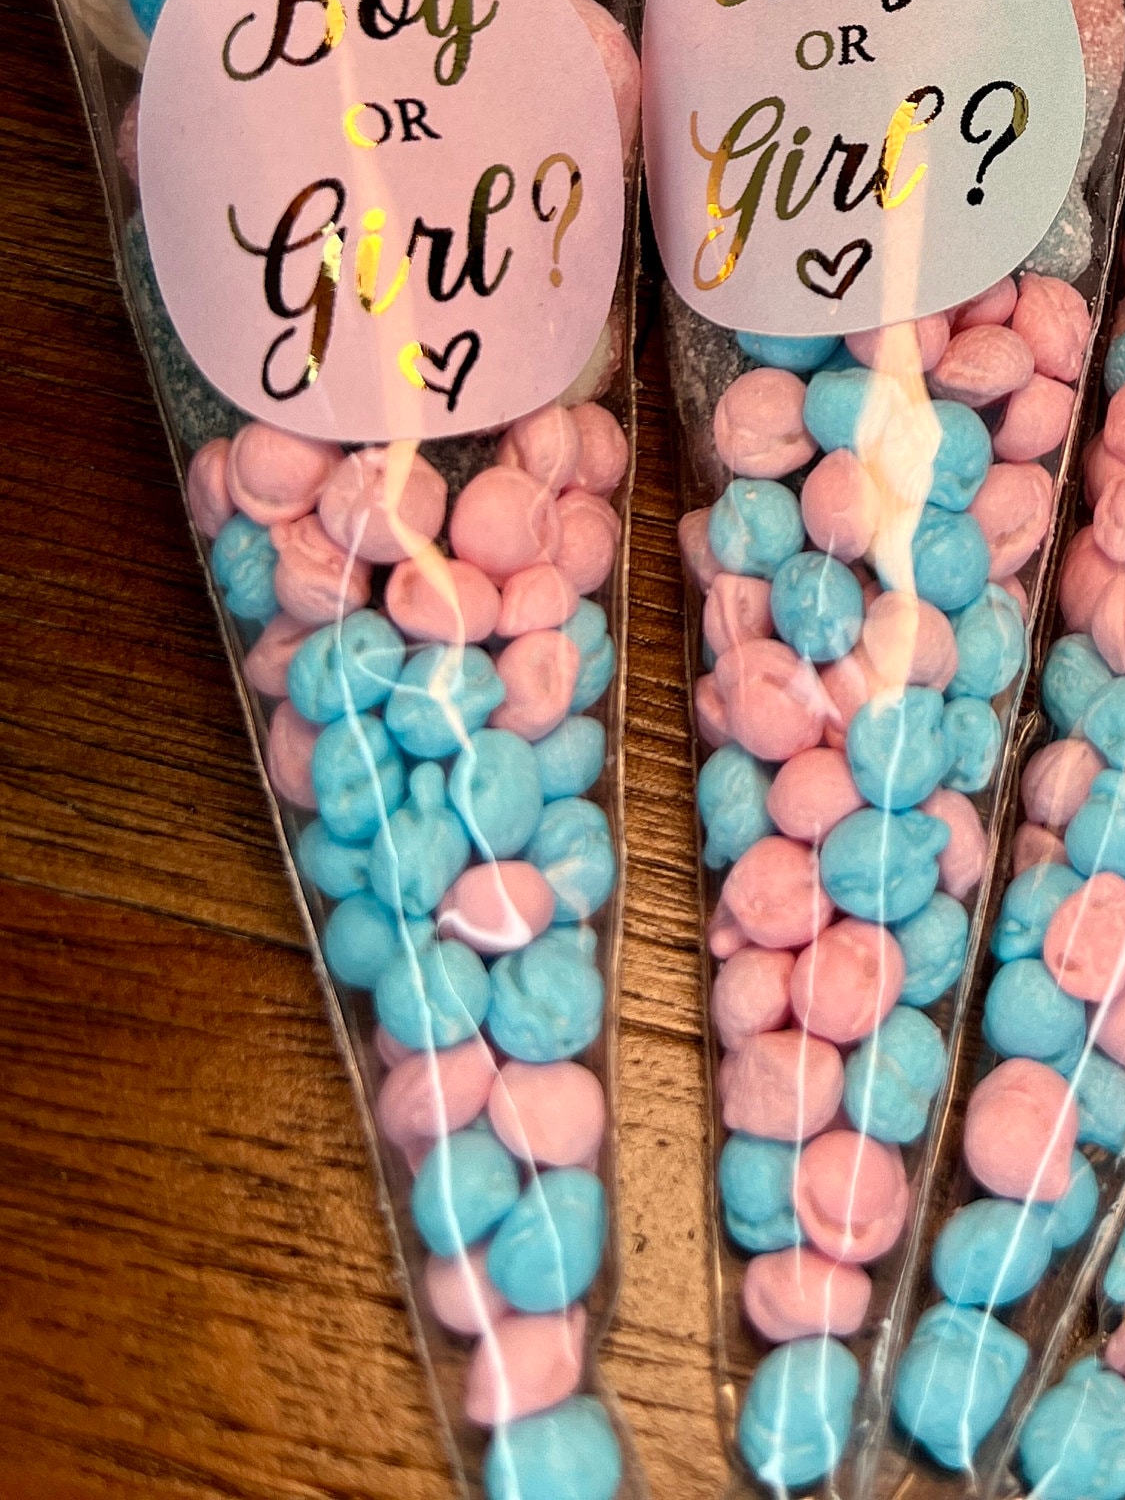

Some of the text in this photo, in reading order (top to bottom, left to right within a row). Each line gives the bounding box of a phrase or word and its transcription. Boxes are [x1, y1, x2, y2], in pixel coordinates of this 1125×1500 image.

[796, 25, 875, 70] OR
[343, 98, 442, 150] OR
[690, 80, 1029, 290] Girl?
[228, 152, 584, 400] Girl?
